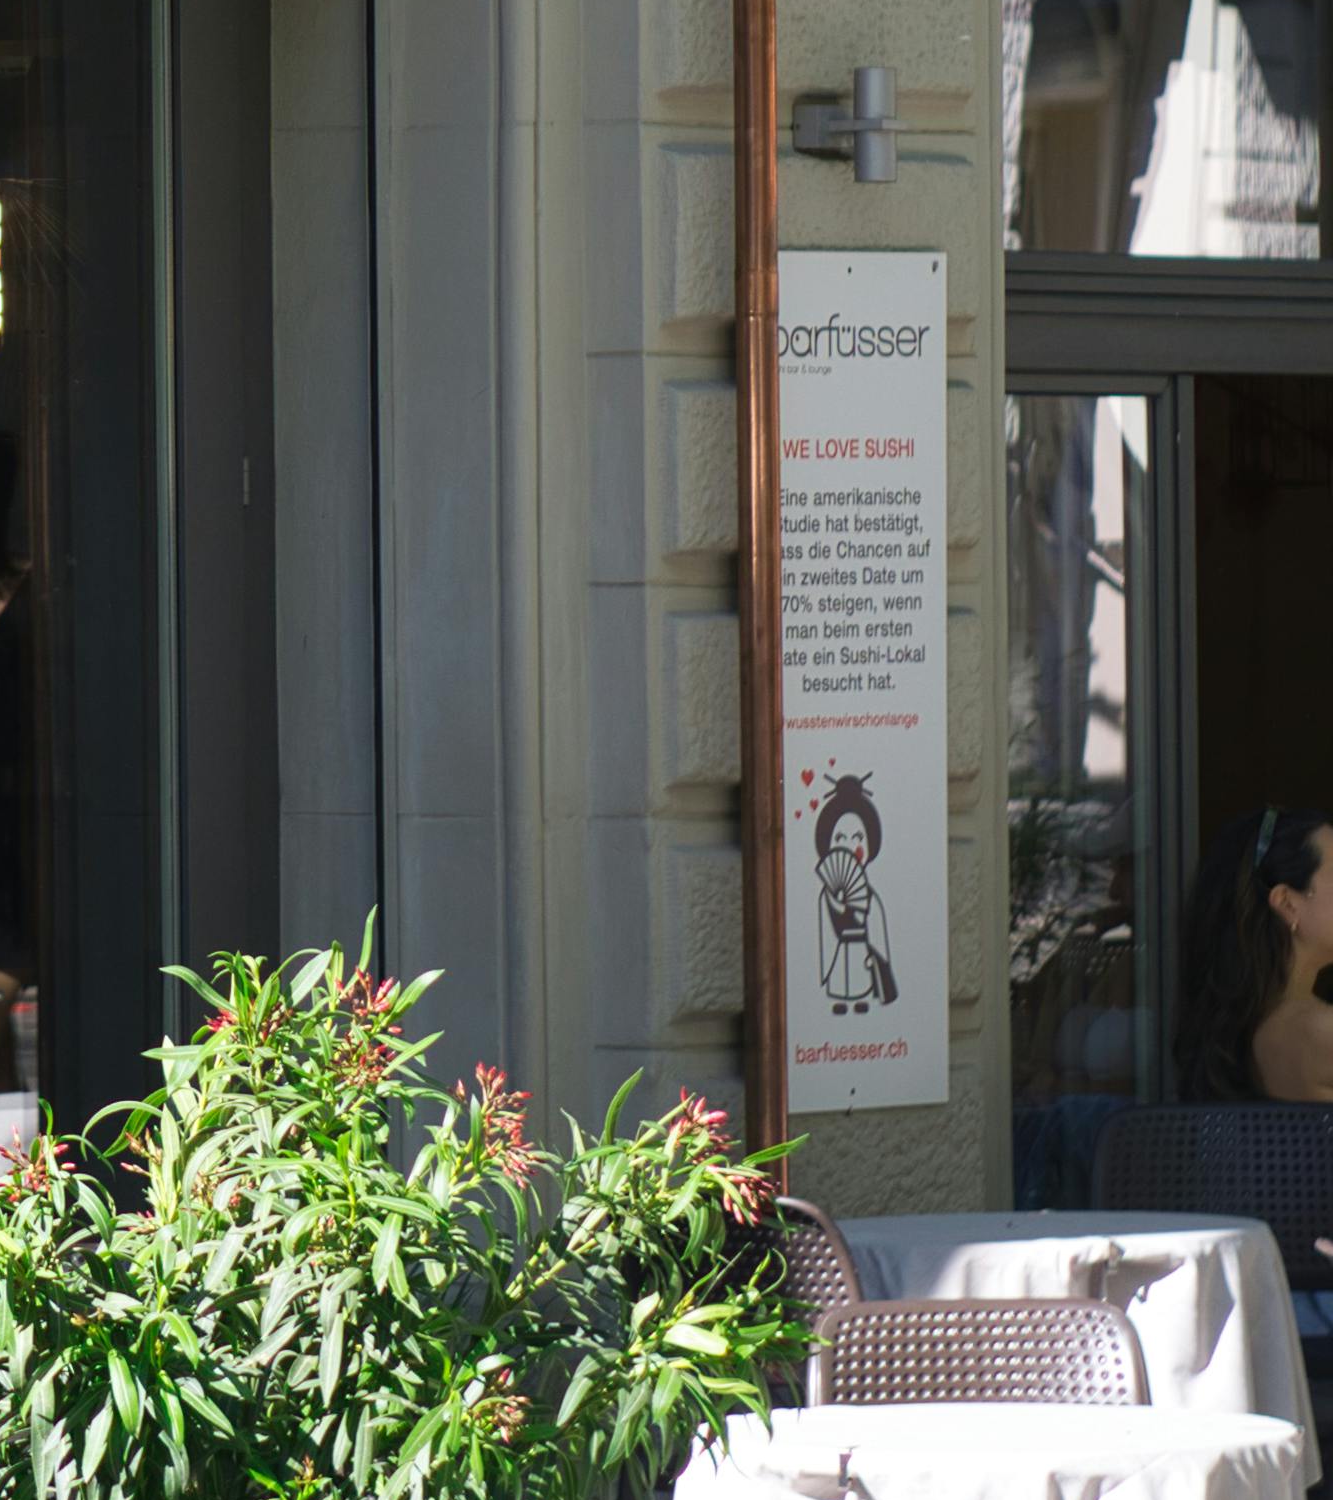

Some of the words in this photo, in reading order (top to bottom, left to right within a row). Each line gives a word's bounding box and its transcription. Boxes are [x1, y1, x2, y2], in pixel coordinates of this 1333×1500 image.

[783, 438, 810, 459] WE
[816, 438, 860, 459] LOVE
[865, 437, 915, 458] SUSHI
[813, 486, 922, 506] amerikanische
[826, 514, 849, 533] hat
[854, 512, 923, 535] bestätigt,
[809, 541, 831, 560] die
[837, 539, 902, 559] Chancen
[907, 538, 931, 557] auf
[801, 567, 857, 586] zweites
[863, 566, 897, 585] Date
[901, 569, 924, 584] um
[782, 595, 813, 613] 70%
[818, 593, 878, 616] steigen,
[884, 595, 923, 610] wenn
[785, 624, 818, 640] man
[823, 620, 860, 639] beim
[865, 620, 913, 638] ersten
[813, 647, 836, 666] ein
[840, 644, 926, 665] Sushi-Lokal
[802, 672, 863, 693] besucht
[868, 672, 896, 691] hat.
[794, 1036, 909, 1065] barfuesser.ch
